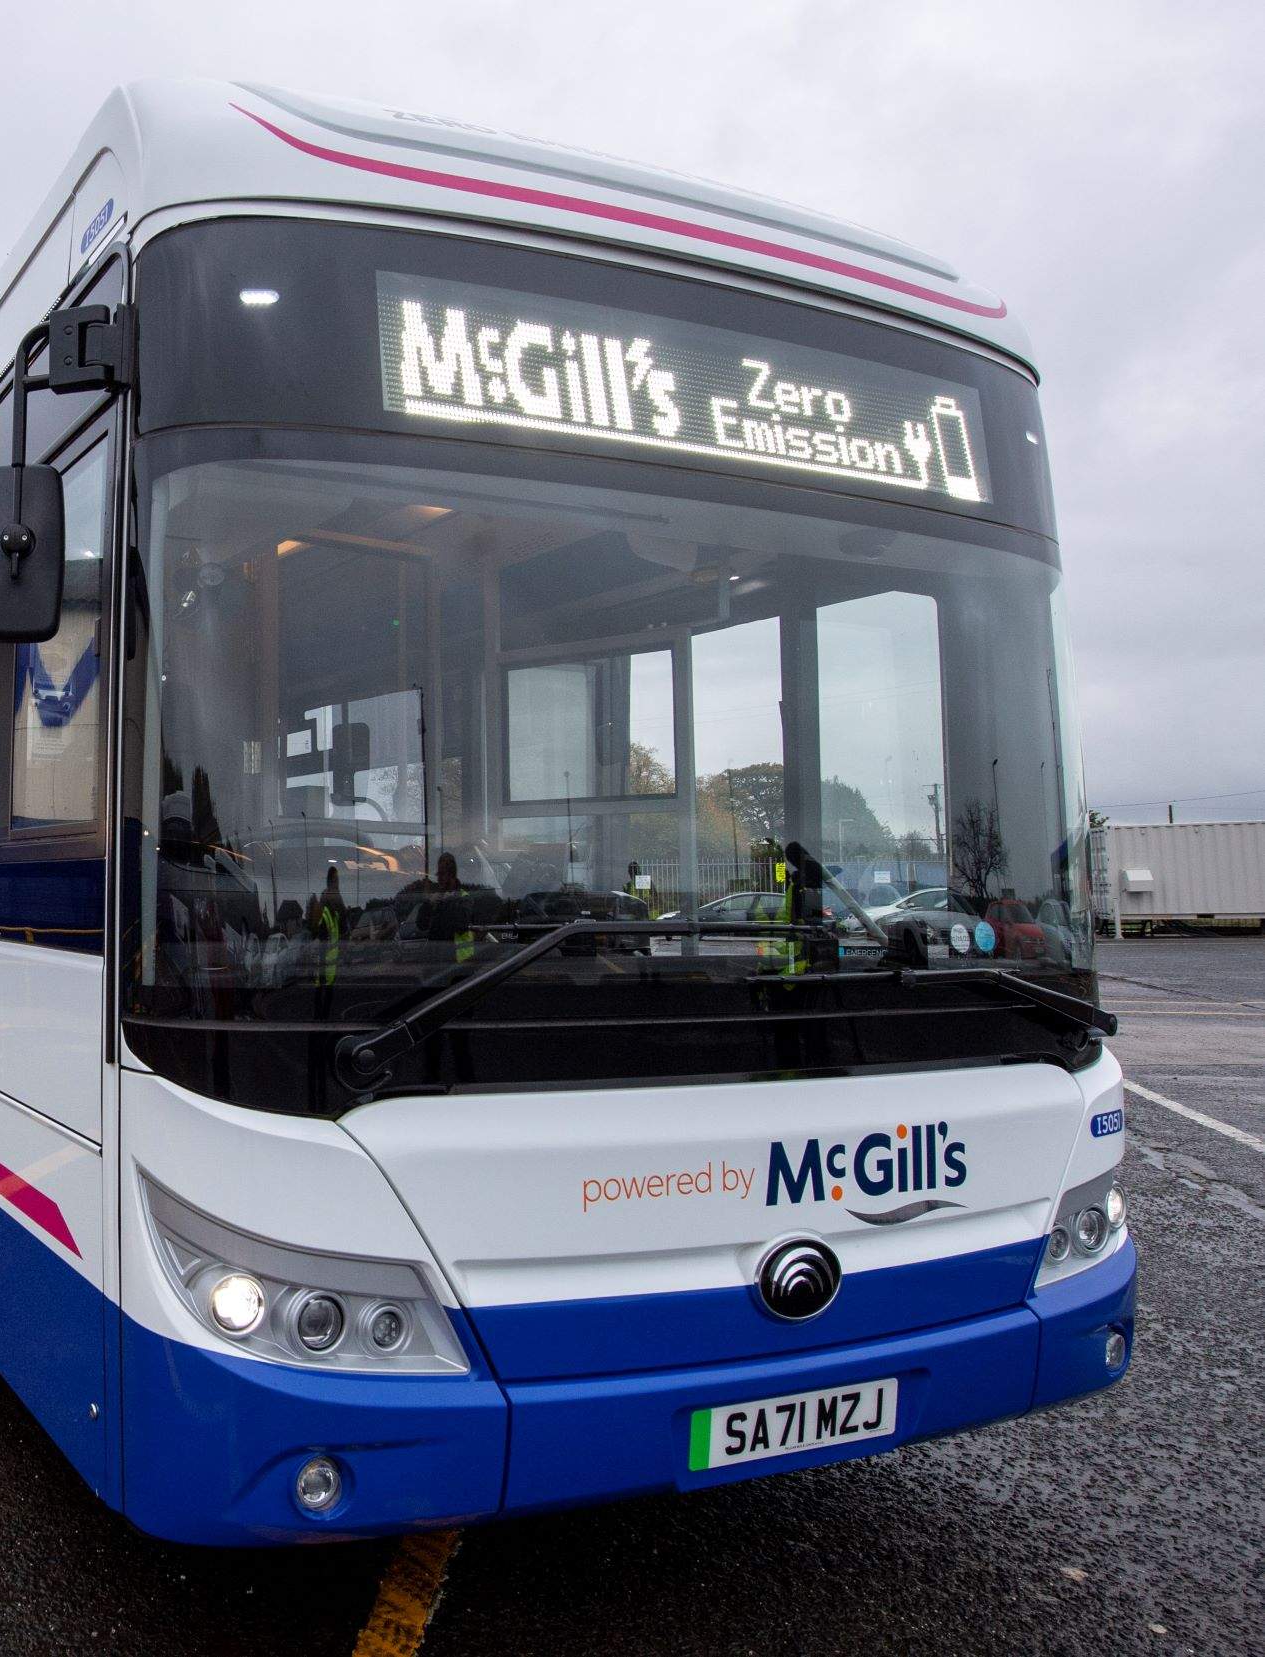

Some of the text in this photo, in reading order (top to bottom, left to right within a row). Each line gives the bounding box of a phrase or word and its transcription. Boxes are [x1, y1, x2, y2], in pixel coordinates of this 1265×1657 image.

[402, 300, 681, 437] McGill's
[741, 358, 852, 422] Zero
[710, 395, 903, 473] Emission
[846, 948, 889, 958] EMERGENC
[582, 1121, 968, 1212] powered by McGill's
[724, 1387, 885, 1457] SA71 MZJ
